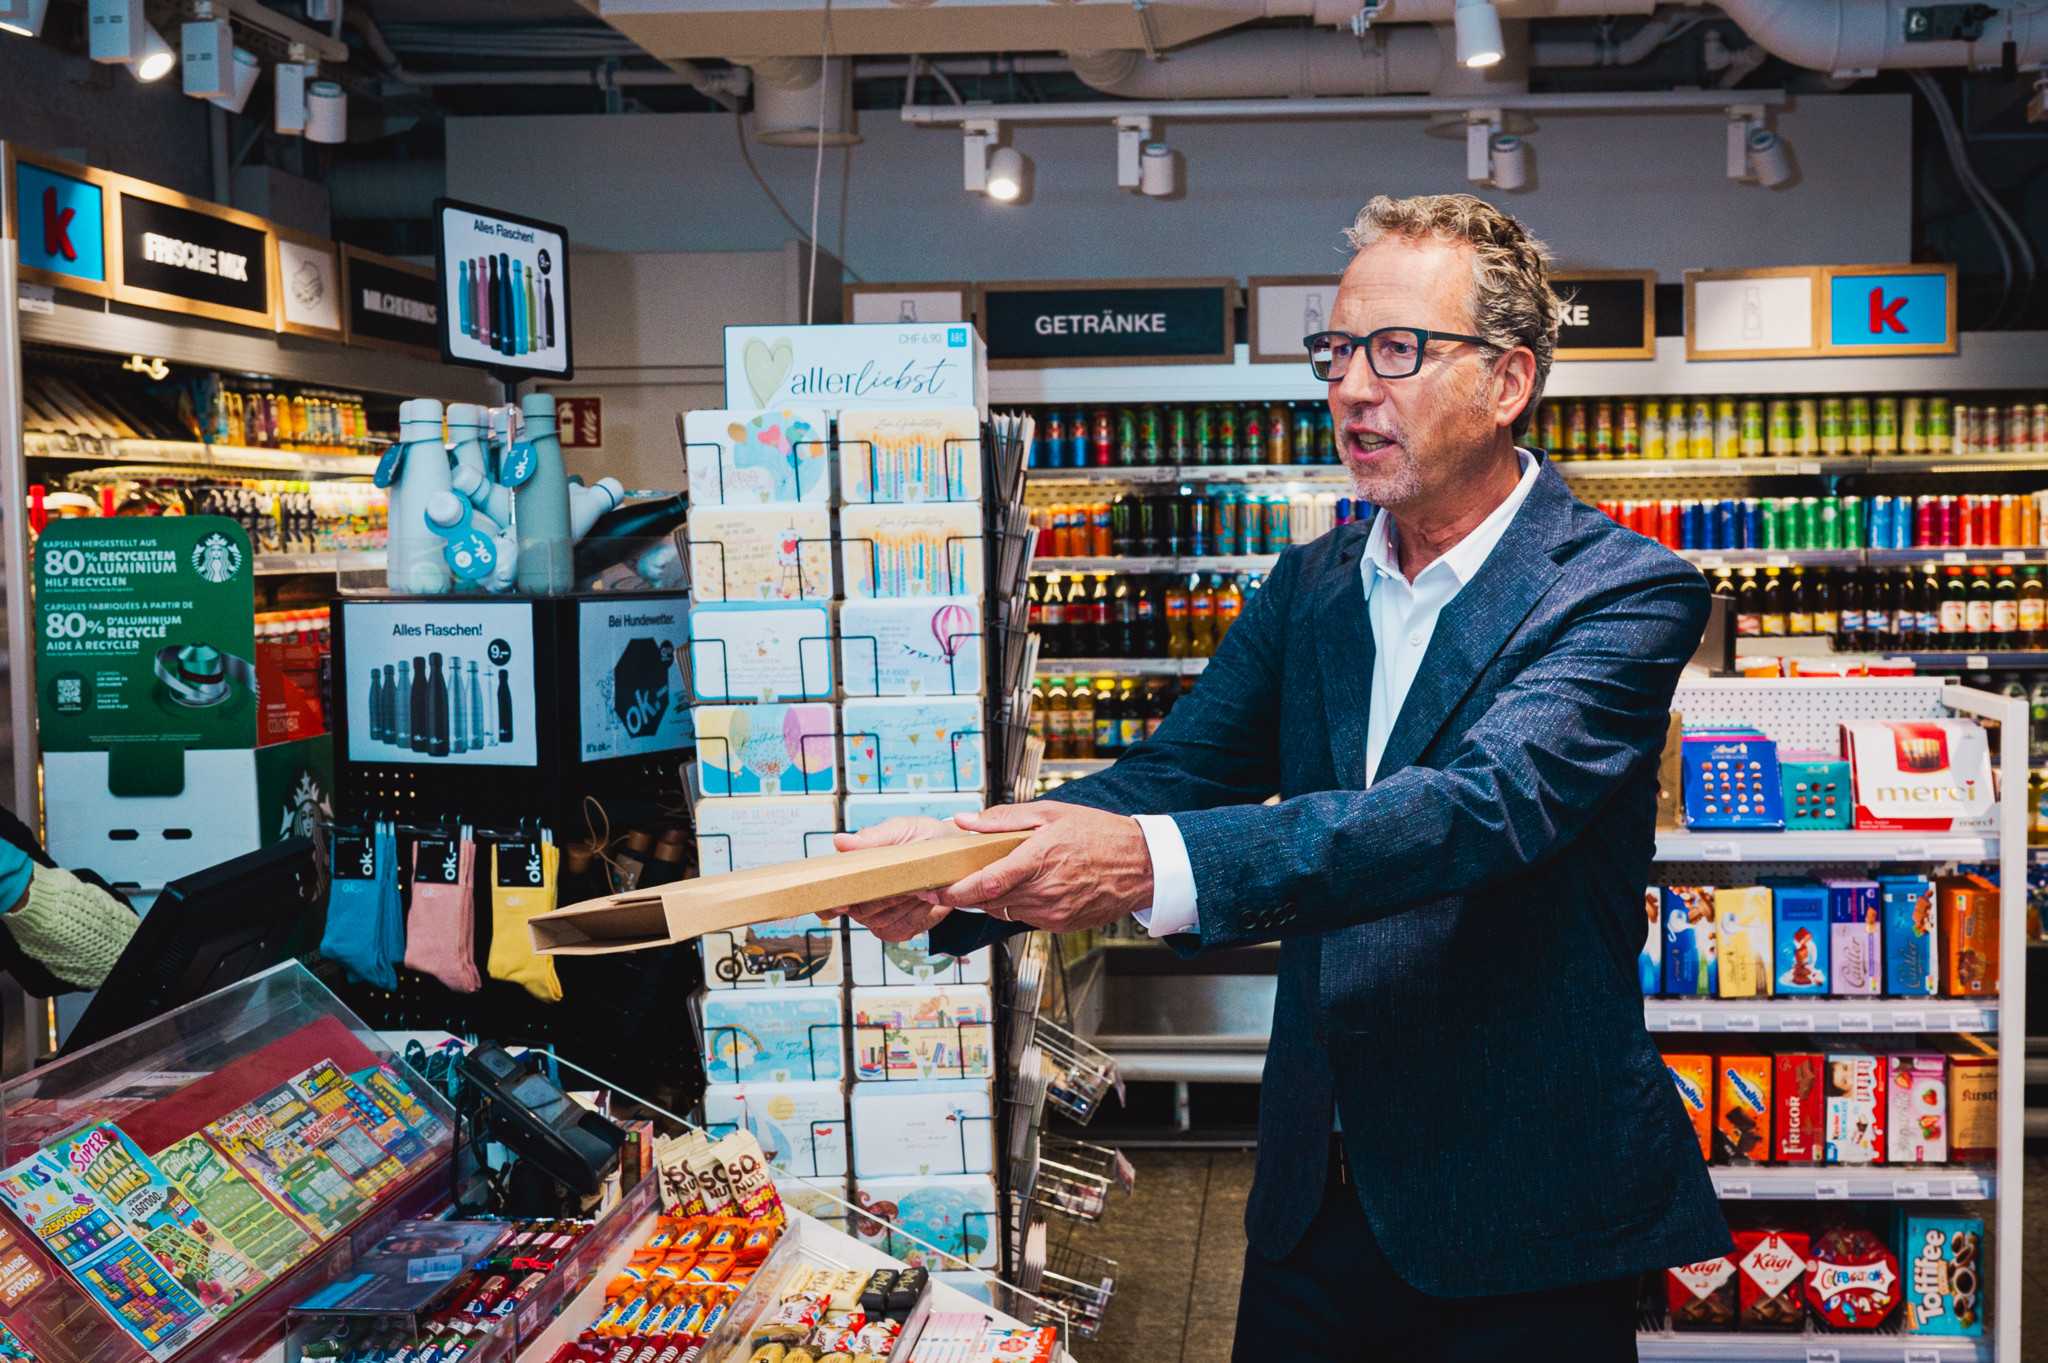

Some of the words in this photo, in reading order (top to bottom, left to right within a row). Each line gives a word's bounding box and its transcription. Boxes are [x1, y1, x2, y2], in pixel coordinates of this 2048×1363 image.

[43, 186, 77, 261] k
[474, 219, 495, 236] Alles
[496, 223, 535, 244] Flaschen!
[219, 251, 248, 283] MIX
[1869, 286, 1910, 333] k
[1035, 310, 1166, 335] GETRÄNKE
[899, 333, 920, 344] CHF
[922, 333, 942, 344] 6.90
[950, 332, 964, 343] ABC
[791, 357, 959, 396] allerliebst
[42, 539, 81, 548] KAPSELN
[82, 539, 138, 548] HERGESTELLT
[139, 538, 157, 547] AUS
[86, 561, 178, 575] ALUMINIUM
[99, 550, 176, 562] RECYCELTEM
[45, 577, 69, 587] HILF
[71, 576, 127, 587] RECYCLEN
[44, 603, 87, 612] CAPSULES
[88, 601, 140, 611] FABRIQUÉES
[150, 601, 180, 610] PARTIR
[182, 600, 194, 609] DE
[45, 612, 105, 638] 80%
[106, 615, 182, 625] D'ALUMINIUM
[107, 624, 167, 639] RECYCLÉ
[392, 623, 422, 636] Alles
[425, 623, 483, 636] Flaschen!
[608, 615, 622, 628] Bei
[624, 613, 676, 628] Hundewetter.
[46, 641, 73, 651] AIDE
[75, 638, 83, 650] À
[85, 640, 140, 650] RECYCLER
[1877, 780, 1977, 803] merci
[1726, 1068, 1766, 1114] ovomaltine
[222, 1120, 242, 1137] WIN
[246, 1115, 273, 1137] LIFE
[1781, 1096, 1806, 1155] FRIGOR
[70, 1131, 107, 1172] SUPER
[83, 1140, 134, 1191] LUCKY
[0, 1164, 51, 1199] TETRIS
[102, 1163, 150, 1206] LINES
[709, 1181, 732, 1199] NUT
[735, 1170, 765, 1194] NUTS
[743, 1182, 775, 1211] COFFEE!
[1752, 1251, 1795, 1271] Kägi
[1913, 1229, 1946, 1325] Toffifee
